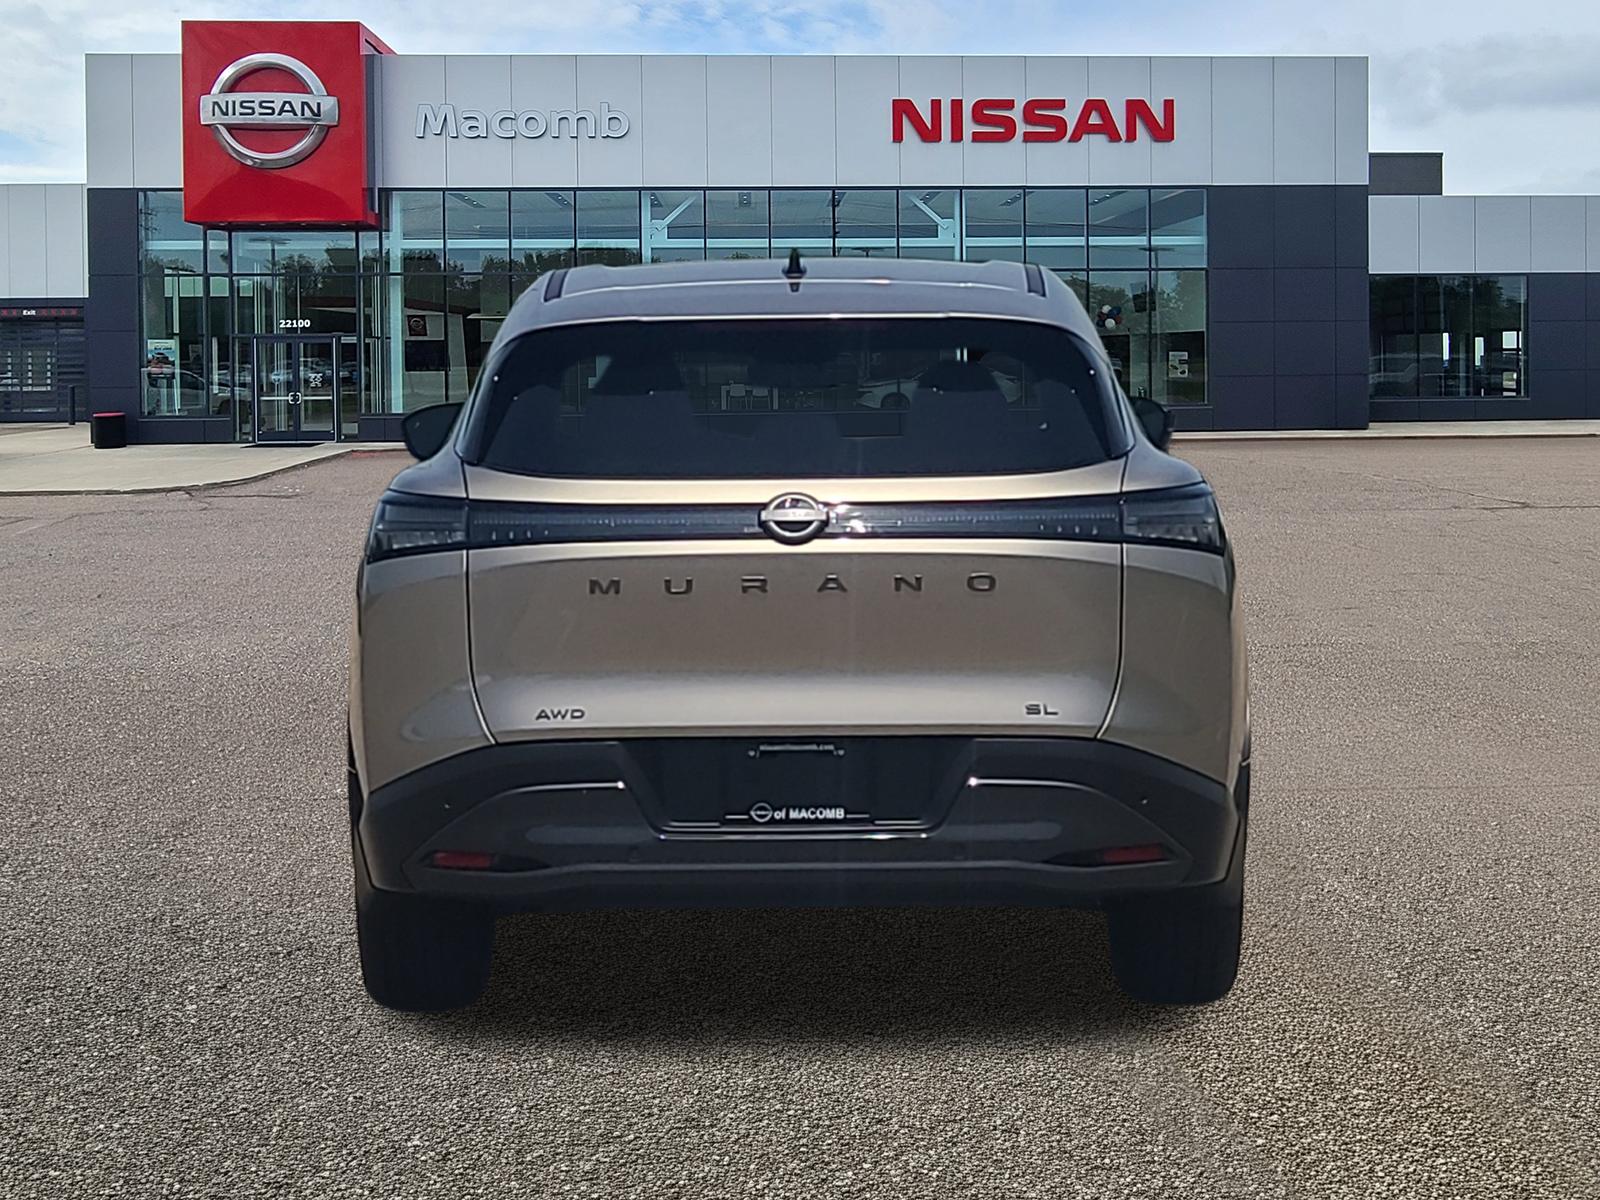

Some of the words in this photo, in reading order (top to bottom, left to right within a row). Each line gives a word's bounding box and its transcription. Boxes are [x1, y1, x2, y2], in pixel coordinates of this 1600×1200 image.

[212, 100, 321, 117] NISSAN
[415, 102, 630, 138] Macomb
[892, 98, 1175, 143] NISSAN
[279, 319, 311, 329] 22100
[588, 572, 997, 596] MURANO
[535, 708, 586, 721] AWD
[1025, 703, 1060, 716] SL
[773, 808, 787, 820] of
[789, 807, 845, 820] MACOMB
